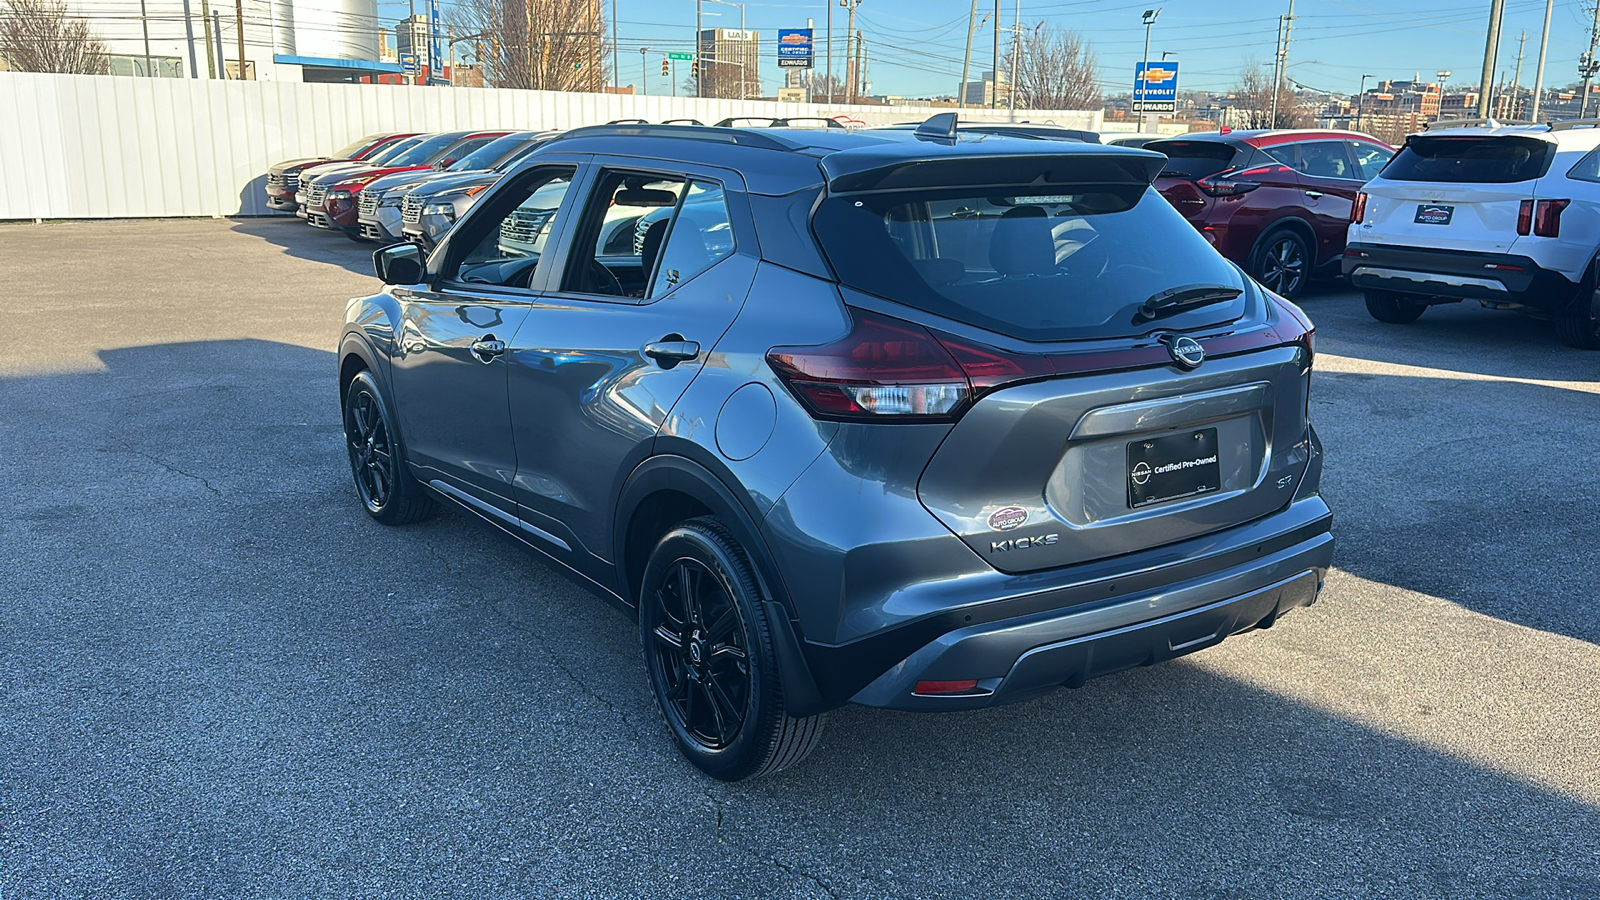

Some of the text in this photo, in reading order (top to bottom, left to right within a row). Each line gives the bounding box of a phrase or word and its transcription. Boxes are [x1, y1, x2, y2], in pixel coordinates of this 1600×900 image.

[728, 31, 748, 39] UAB
[1133, 103, 1174, 111] EDWARDS
[1173, 345, 1204, 356] NISSAN
[1154, 455, 1217, 474] Certified Pre-Owned
[1132, 469, 1152, 477] NISSAN
[993, 520, 1007, 528] AUTO
[1008, 516, 1026, 524] GROUP
[990, 533, 1059, 553] KICKS
